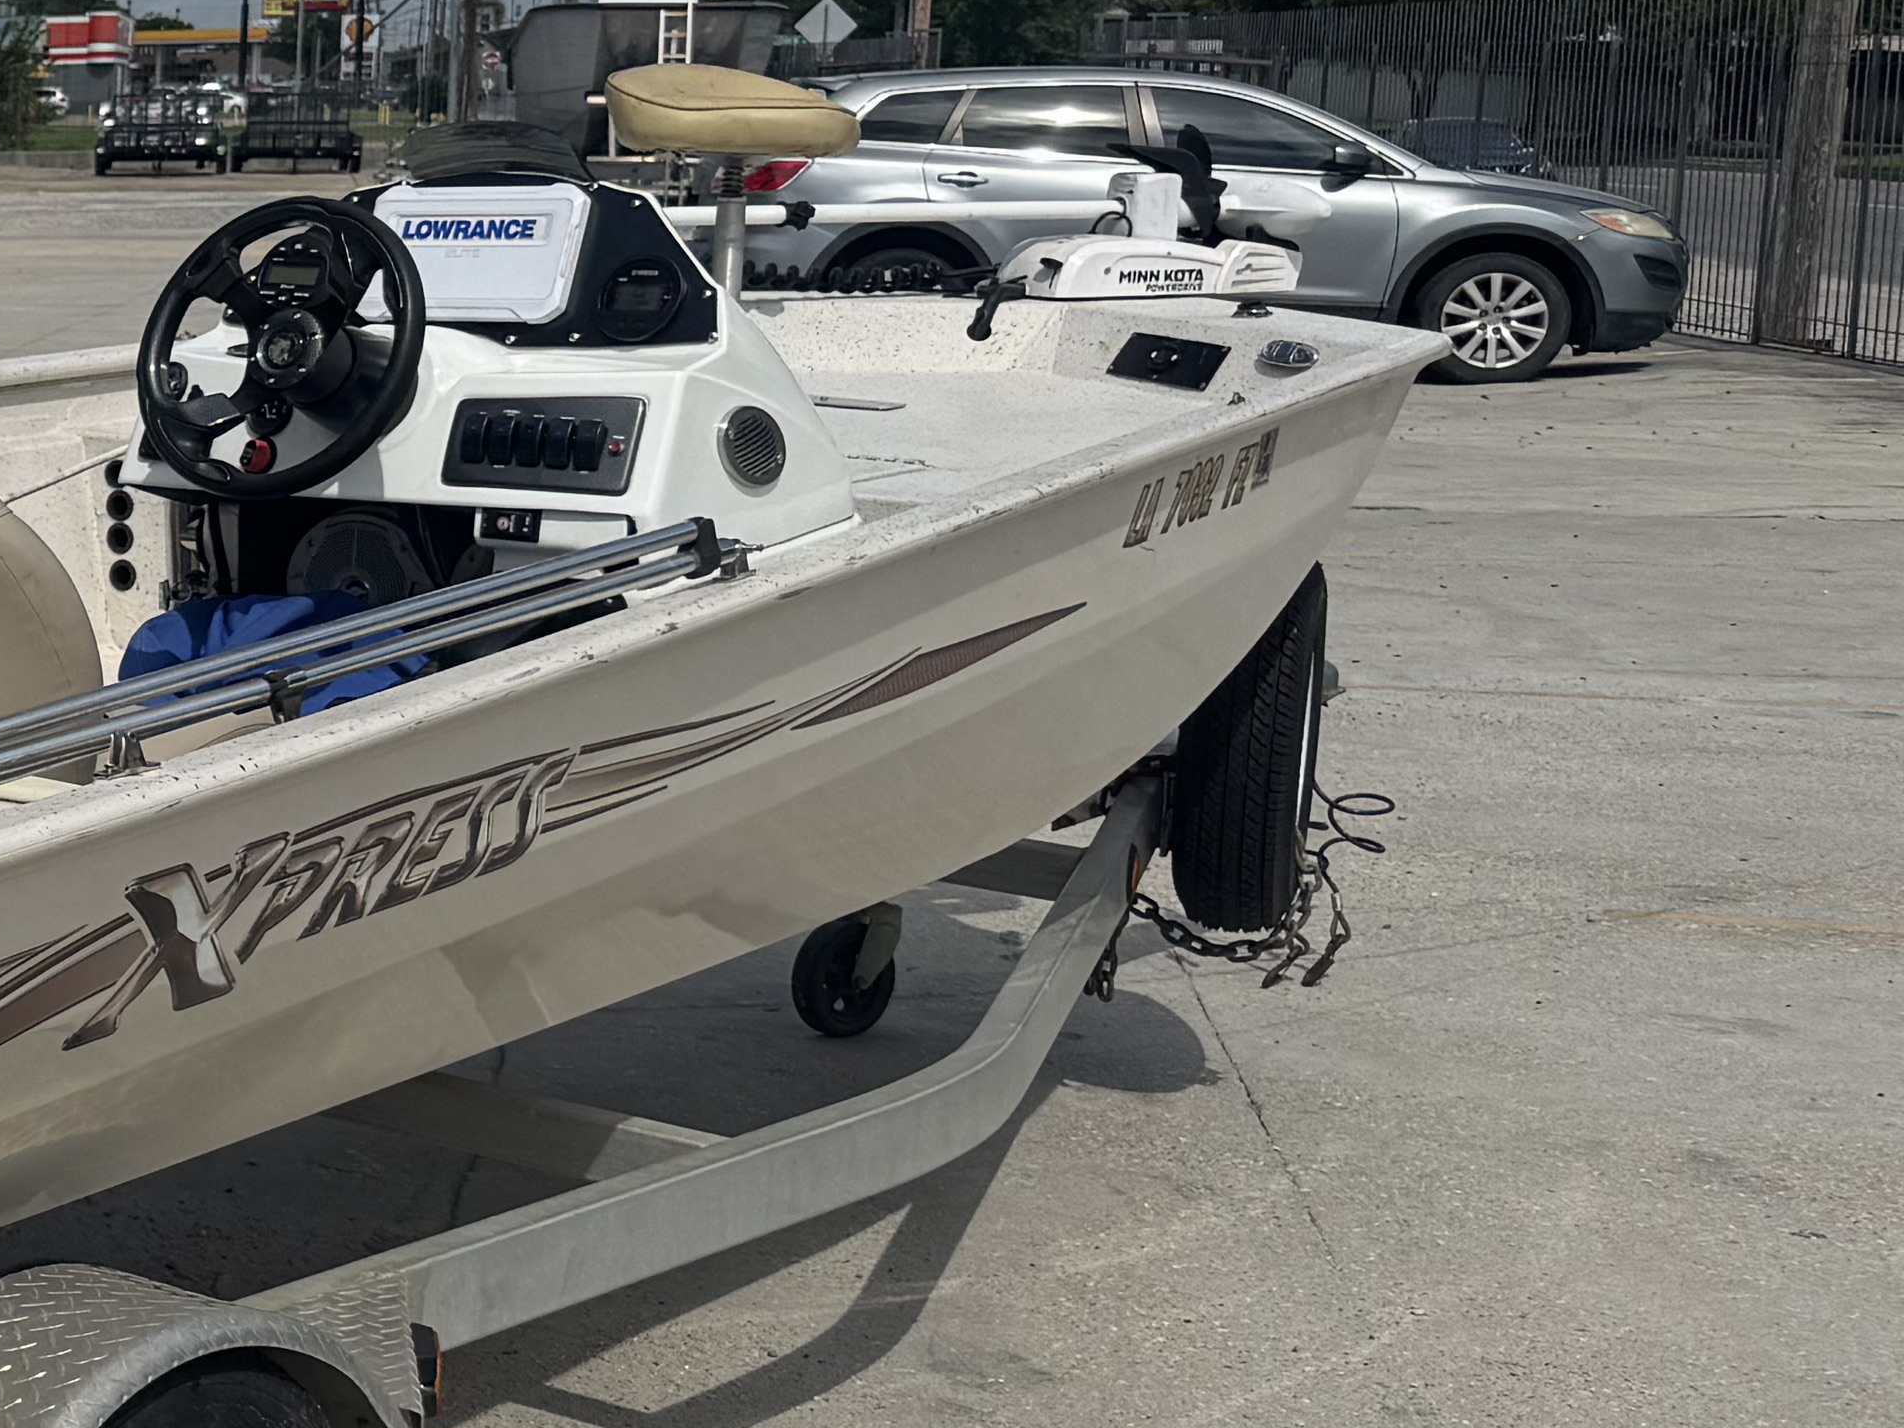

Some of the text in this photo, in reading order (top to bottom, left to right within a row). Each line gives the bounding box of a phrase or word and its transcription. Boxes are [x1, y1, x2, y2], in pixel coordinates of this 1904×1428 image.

[401, 219, 537, 241] LOWRANCE
[1118, 268, 1204, 284] MINN KOTA
[62, 747, 580, 1050] XPRESS
